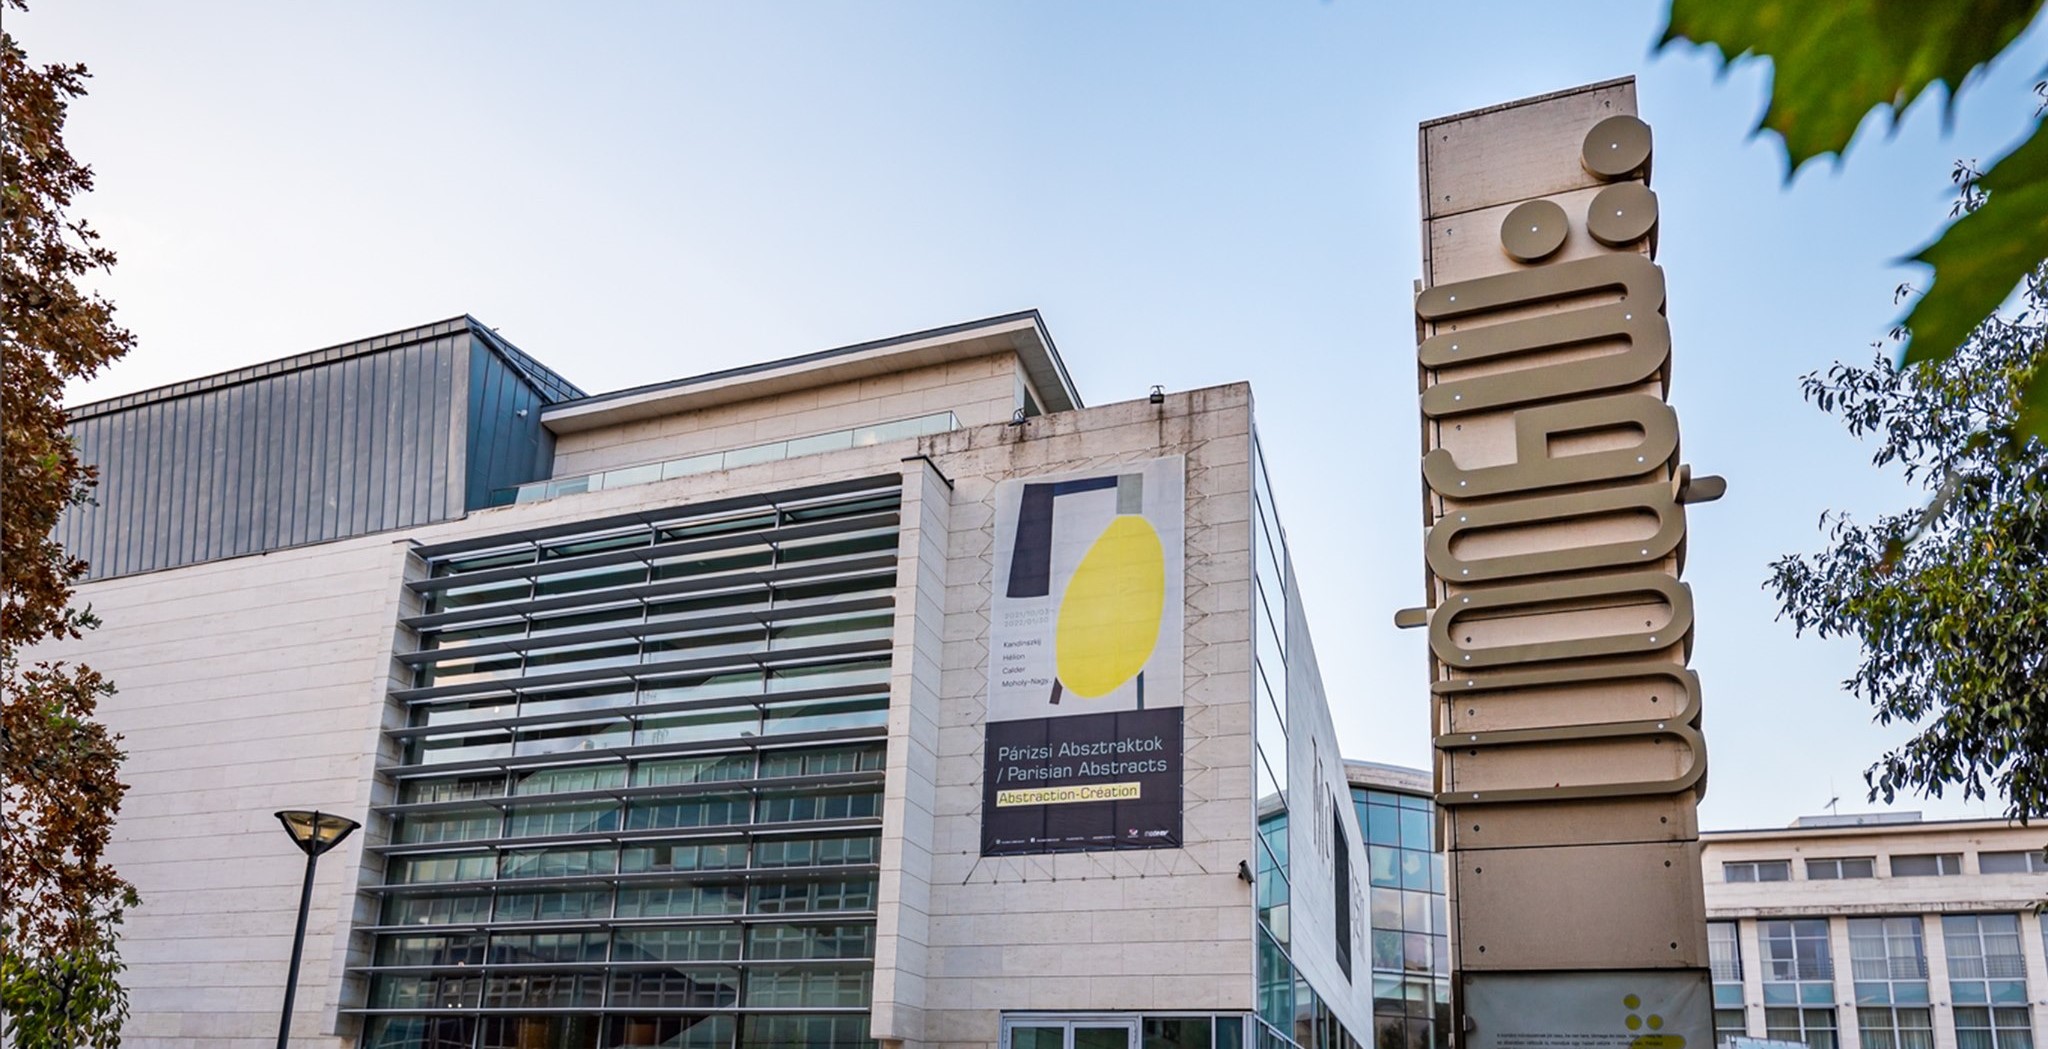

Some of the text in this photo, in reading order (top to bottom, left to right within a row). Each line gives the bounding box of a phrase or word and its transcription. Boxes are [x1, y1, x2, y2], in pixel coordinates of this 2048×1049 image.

[1002, 666, 1025, 674] Calder
[998, 736, 1163, 762] Párizsi Absztraktok
[1007, 764, 1073, 782] Parisian
[1077, 759, 1168, 777] Abstracts
[998, 785, 1138, 804] Abstraction-Création
